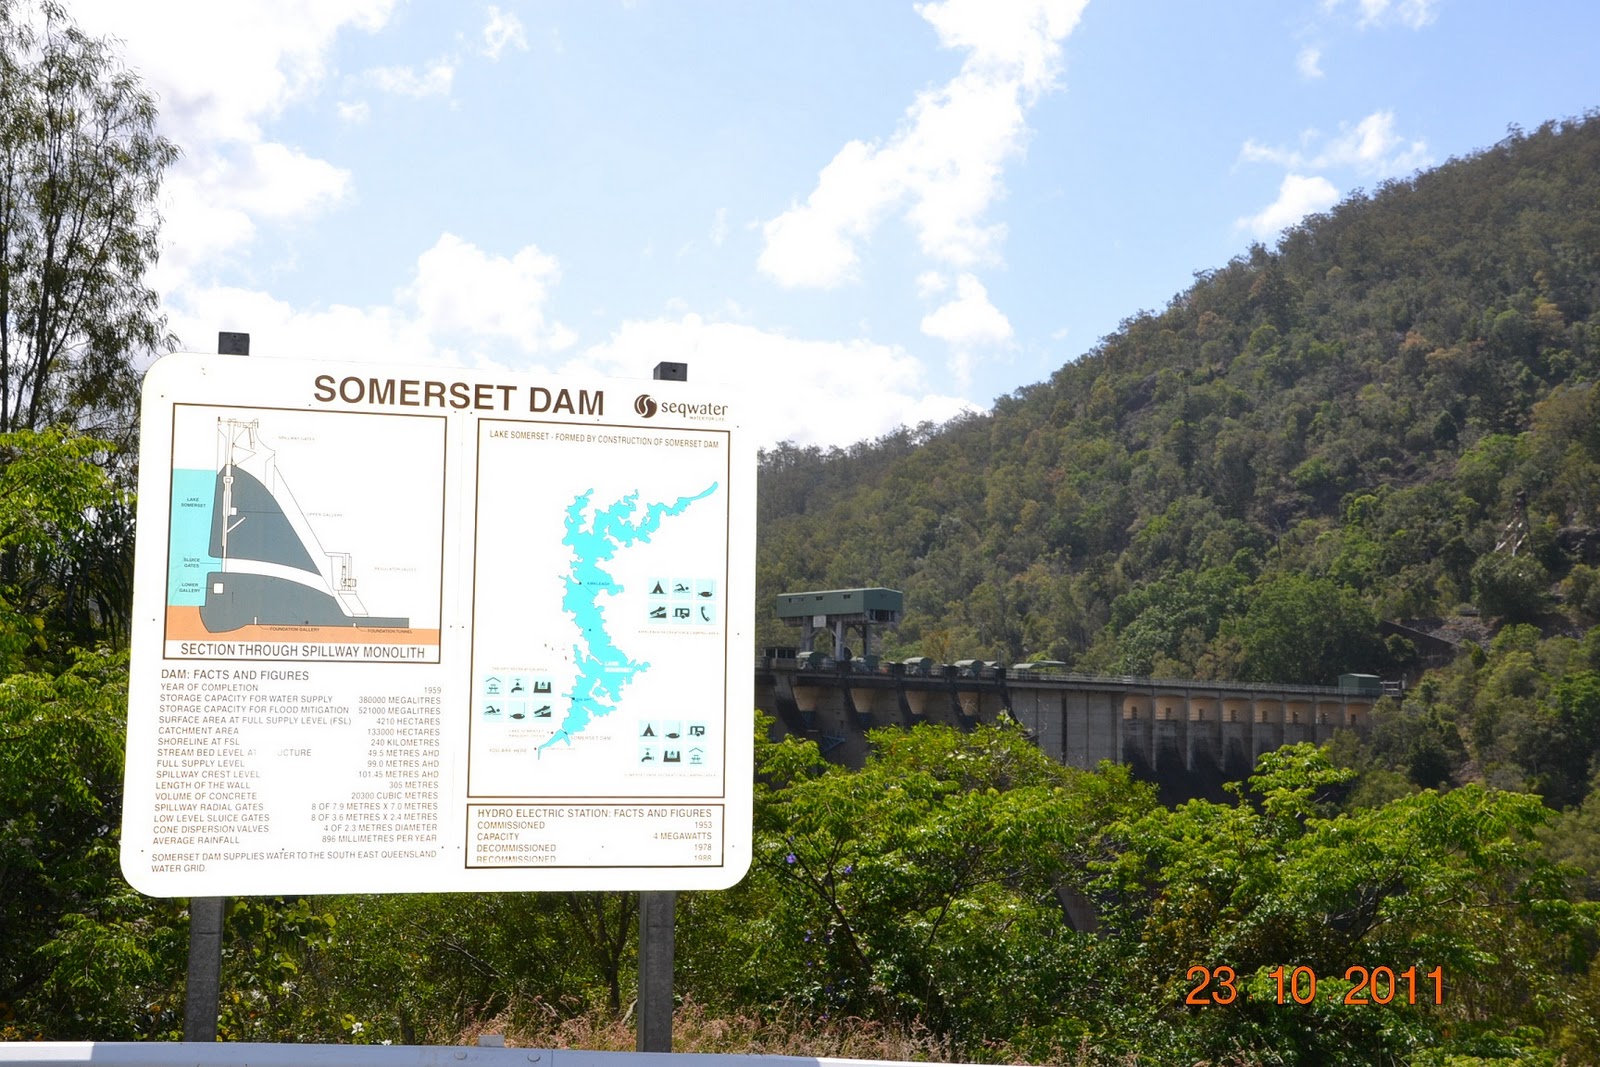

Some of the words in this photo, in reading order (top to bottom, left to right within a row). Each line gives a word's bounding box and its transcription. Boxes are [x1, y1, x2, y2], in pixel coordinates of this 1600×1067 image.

[313, 374, 517, 411] SOMERSET
[529, 386, 604, 416] DAM
[660, 402, 728, 418] seqwater
[489, 430, 509, 439] LAKE
[511, 431, 549, 440] SOMERSET
[555, 433, 585, 442] FORMED
[587, 435, 596, 443] BY
[598, 435, 652, 446] CONSTRUCTION
[654, 438, 663, 446] OF
[665, 439, 702, 448] SOMERSET
[704, 440, 719, 448] DAM
[181, 643, 235, 655] SECTION
[238, 644, 298, 656] THROUGH
[302, 645, 360, 657] SPILLWAY
[363, 646, 425, 658] MONOLITH
[161, 669, 190, 680] DAM:
[193, 669, 230, 680] FACTS
[233, 670, 257, 680] AND
[260, 670, 309, 681] FIGURES
[161, 683, 185, 691] YEAR
[187, 683, 199, 691] OF
[201, 683, 259, 692] COMPLETION
[424, 686, 442, 694] 1959
[160, 694, 202, 702] STORAGE
[204, 694, 247, 703] CAPACITY
[249, 695, 267, 703] FOR
[269, 695, 299, 703] WATER
[300, 695, 333, 703] SUPPLY
[359, 696, 386, 704] 380000
[388, 696, 441, 705] MEGALITRES
[159, 705, 201, 713] STORAGE
[204, 705, 247, 713] CAPACITY
[249, 705, 267, 713] FOR
[269, 706, 299, 714] FLOOD
[300, 706, 349, 714] MITIGATION
[358, 707, 386, 715] 521000
[387, 707, 441, 715] MEGALITRES
[159, 716, 200, 724] SURFACE
[202, 716, 226, 724] AREA
[229, 716, 240, 724] AT
[242, 716, 263, 724] FULL
[266, 716, 299, 725] SUPPLY
[301, 717, 328, 725] LEVEL
[329, 717, 352, 726] (FSL)
[396, 718, 441, 726] HECTARES
[158, 726, 213, 735] CATCHMENT
[215, 727, 239, 735] AREA
[367, 728, 394, 736] 133000
[396, 728, 440, 736] HECTARES
[157, 737, 208, 746] SHORELINE
[224, 738, 240, 746] FSL
[387, 739, 440, 747] KILOMETRES
[157, 748, 194, 757] STREAM
[196, 748, 215, 757] BED
[217, 749, 245, 757] LEVEL
[367, 749, 384, 757] 49.5
[386, 749, 420, 757] METRES
[422, 749, 440, 757] AHD
[156, 759, 179, 768] FULL
[181, 759, 215, 768] SUPPLY
[217, 759, 245, 768] LEVEL
[367, 760, 384, 768] 99.0
[385, 760, 420, 768] METRES
[422, 760, 440, 768] AHD
[156, 770, 199, 779] SPILLWAY
[201, 770, 230, 779] CREST
[233, 770, 261, 778] LEVEL
[359, 770, 383, 778] 101.45
[385, 770, 420, 778] METRES
[421, 770, 439, 778] AHD
[155, 781, 192, 790] LENGTH
[194, 781, 206, 789] OF
[208, 781, 224, 789] THE
[389, 781, 403, 789] 305
[405, 781, 439, 789] METRES
[155, 792, 192, 800] VOLUME
[195, 792, 206, 800] OF
[209, 792, 257, 800] CONCRETE
[351, 792, 374, 800] 20300
[376, 792, 402, 800] CUBIC
[405, 792, 439, 800] METRES
[154, 803, 198, 812] SPILLWAY
[200, 803, 233, 811] RADIAL
[235, 803, 264, 811] GATES
[311, 803, 316, 811] 8
[318, 803, 330, 811] OF
[404, 802, 438, 810] METRES
[346, 813, 380, 821] METRES
[383, 813, 388, 821] X
[404, 813, 438, 821] METRES
[477, 809, 513, 817] HYDRO
[516, 809, 565, 818] ELECTRIC
[567, 809, 611, 818] STATION:
[614, 809, 645, 817] FACTS
[647, 809, 668, 817] AND
[670, 809, 712, 817] FIGURES
[154, 814, 174, 823] LOW
[176, 814, 204, 822] LEVEL
[207, 814, 238, 822] SLUICE
[241, 814, 270, 822] GATES
[153, 825, 178, 834] CONE
[181, 825, 235, 834] DISPERSION
[237, 825, 269, 833] VALVES
[330, 824, 342, 832] OF
[358, 824, 393, 832] METRES
[395, 824, 438, 832] DIAMETER
[477, 821, 546, 829] COMMISSIONED
[695, 821, 713, 829] 1953
[153, 836, 195, 845] AVERAGE
[197, 836, 240, 844] RAINFALL
[322, 835, 336, 843] 896
[338, 835, 394, 843] MILLIMETRES
[396, 834, 413, 842] PER
[414, 834, 437, 842] YEAR
[477, 833, 520, 841] CAPACITY
[660, 832, 712, 840] MEGAWATTS
[476, 844, 557, 852] DECOMMISSIONED
[151, 853, 200, 862] SOMERSET
[202, 853, 222, 861] DAM
[223, 852, 265, 861] SUPPLIES
[266, 852, 295, 860] WATER
[296, 852, 308, 860] TO
[309, 851, 325, 859] THE
[327, 851, 356, 859] SOUTH
[358, 851, 379, 859] EAST
[381, 850, 437, 859] QUEENSLAND
[476, 855, 557, 863] RECOMMISSIONED
[151, 864, 182, 873] WATER
